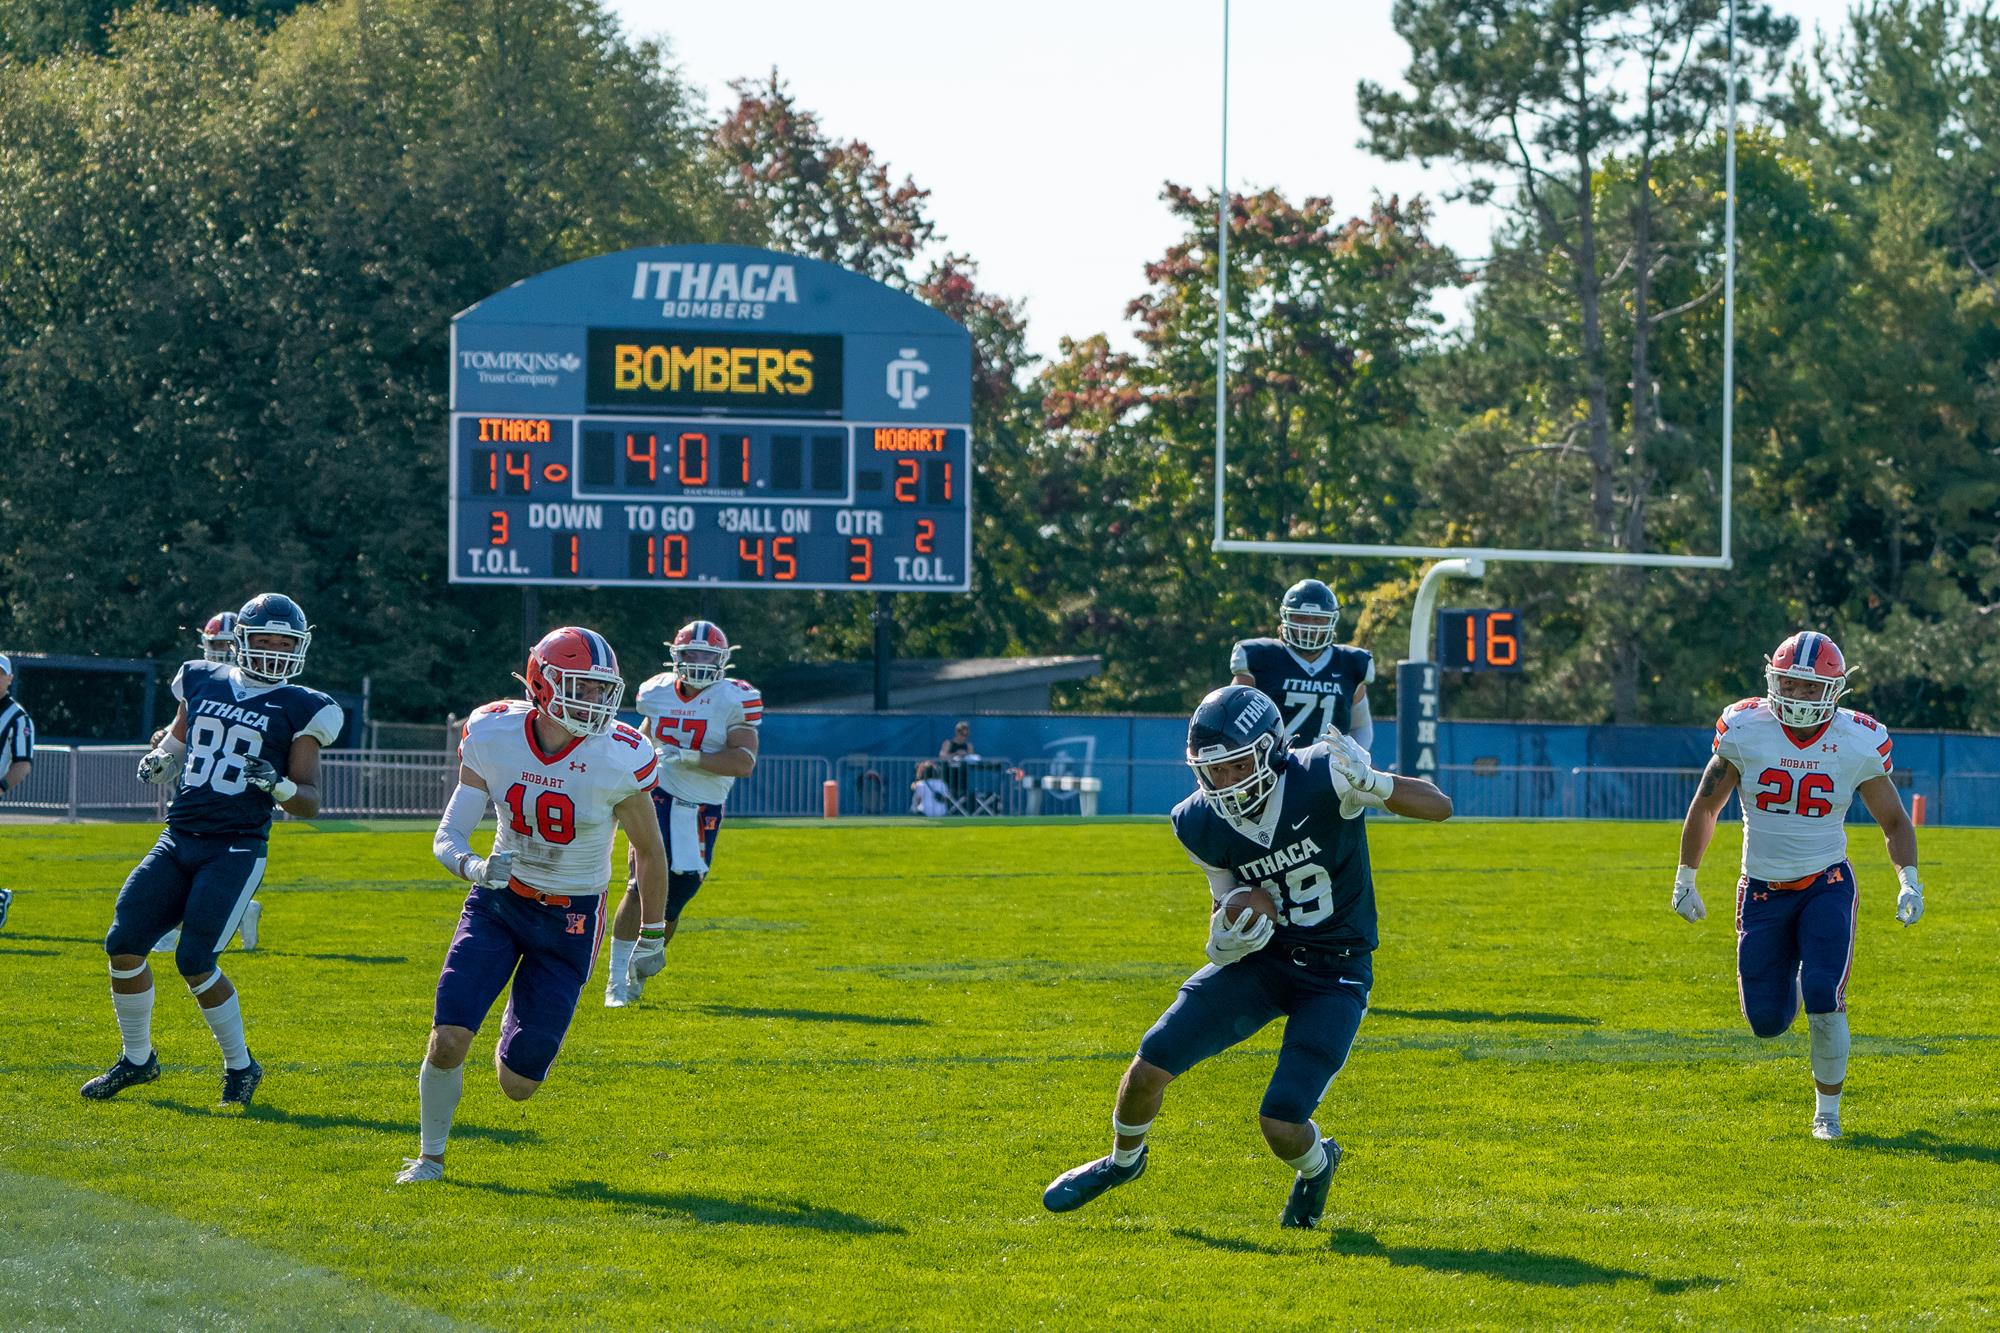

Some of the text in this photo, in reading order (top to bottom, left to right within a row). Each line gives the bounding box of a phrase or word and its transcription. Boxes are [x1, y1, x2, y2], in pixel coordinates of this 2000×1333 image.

[632, 262, 797, 303] ITHACA
[662, 302, 766, 319] BOMBERS
[460, 351, 558, 373] TOMPKINS
[477, 371, 557, 387] Trust Company
[615, 345, 813, 394] BOMBERS
[479, 418, 551, 442] ITHACA
[874, 429, 946, 451] HOBART
[490, 453, 530, 491] 14
[895, 459, 951, 502] 21
[491, 511, 509, 545] 3
[528, 504, 602, 529] DOWN
[624, 506, 695, 531] TO GO
[781, 508, 811, 533] ON
[836, 510, 883, 535] QTR
[915, 520, 935, 553] 2
[468, 549, 530, 574] T.O.L.
[571, 535, 578, 573] 1
[648, 534, 688, 578] 10
[739, 536, 797, 580] 45
[850, 538, 872, 582] 3
[895, 556, 955, 582] T.O.L.
[1466, 612, 1517, 666] 16
[1282, 678, 1342, 695] ITHACA
[196, 700, 270, 732] ITHACA
[1283, 692, 1336, 744] 71
[1415, 667, 1438, 782] ITHA
[656, 717, 708, 751] 57
[184, 715, 264, 796] 88
[1780, 758, 1820, 770] HOBART
[521, 771, 565, 789] HOBART
[1756, 768, 1834, 817] 26
[504, 783, 576, 845] 18
[1238, 837, 1321, 881] ITHACA
